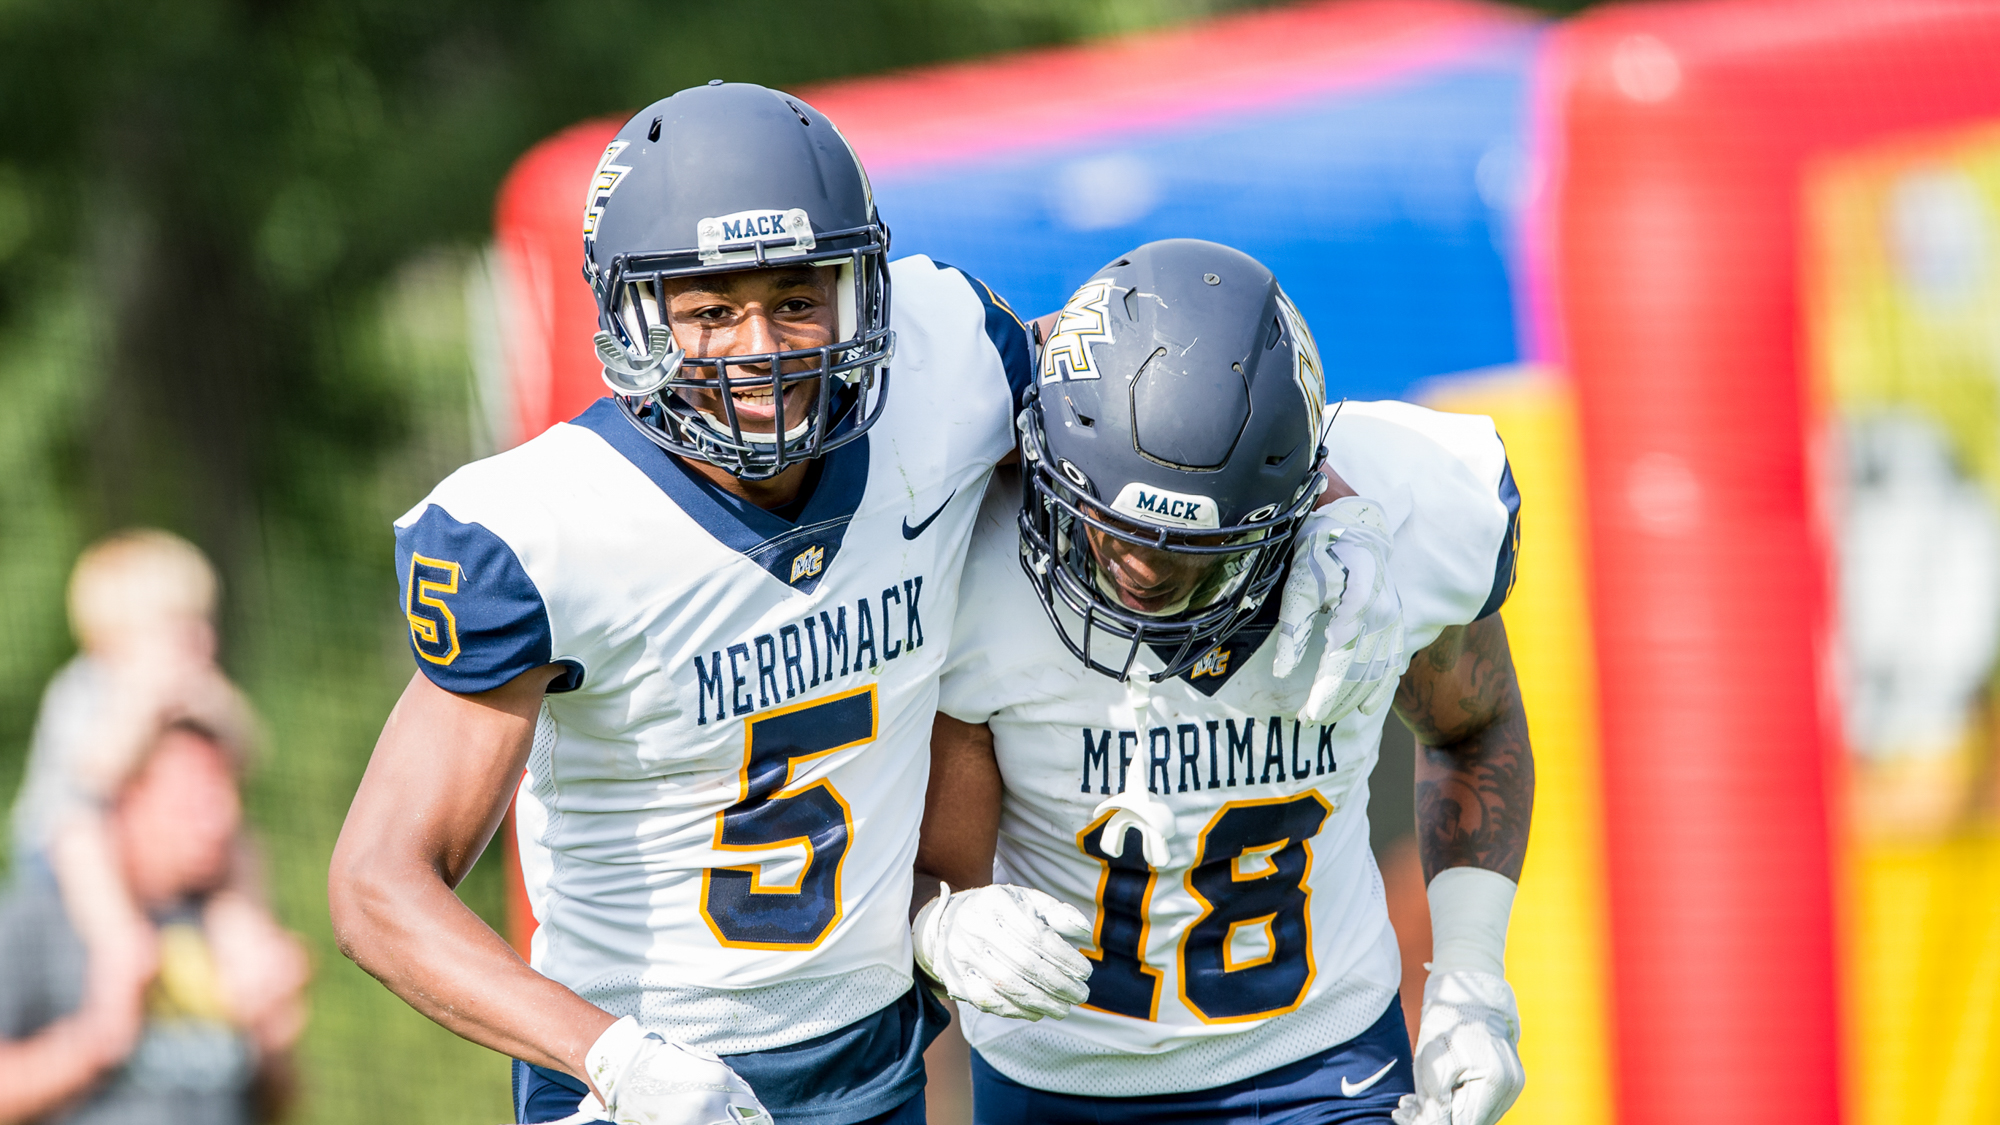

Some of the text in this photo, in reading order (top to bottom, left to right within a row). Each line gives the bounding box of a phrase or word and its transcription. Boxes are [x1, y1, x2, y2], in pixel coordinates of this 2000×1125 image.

[722, 214, 786, 241] MACK
[1136, 491, 1201, 521] MACK
[407, 551, 461, 666] 5
[694, 575, 924, 726] MERRIMACK
[699, 683, 878, 951] 5
[1076, 788, 1334, 1025] 18
